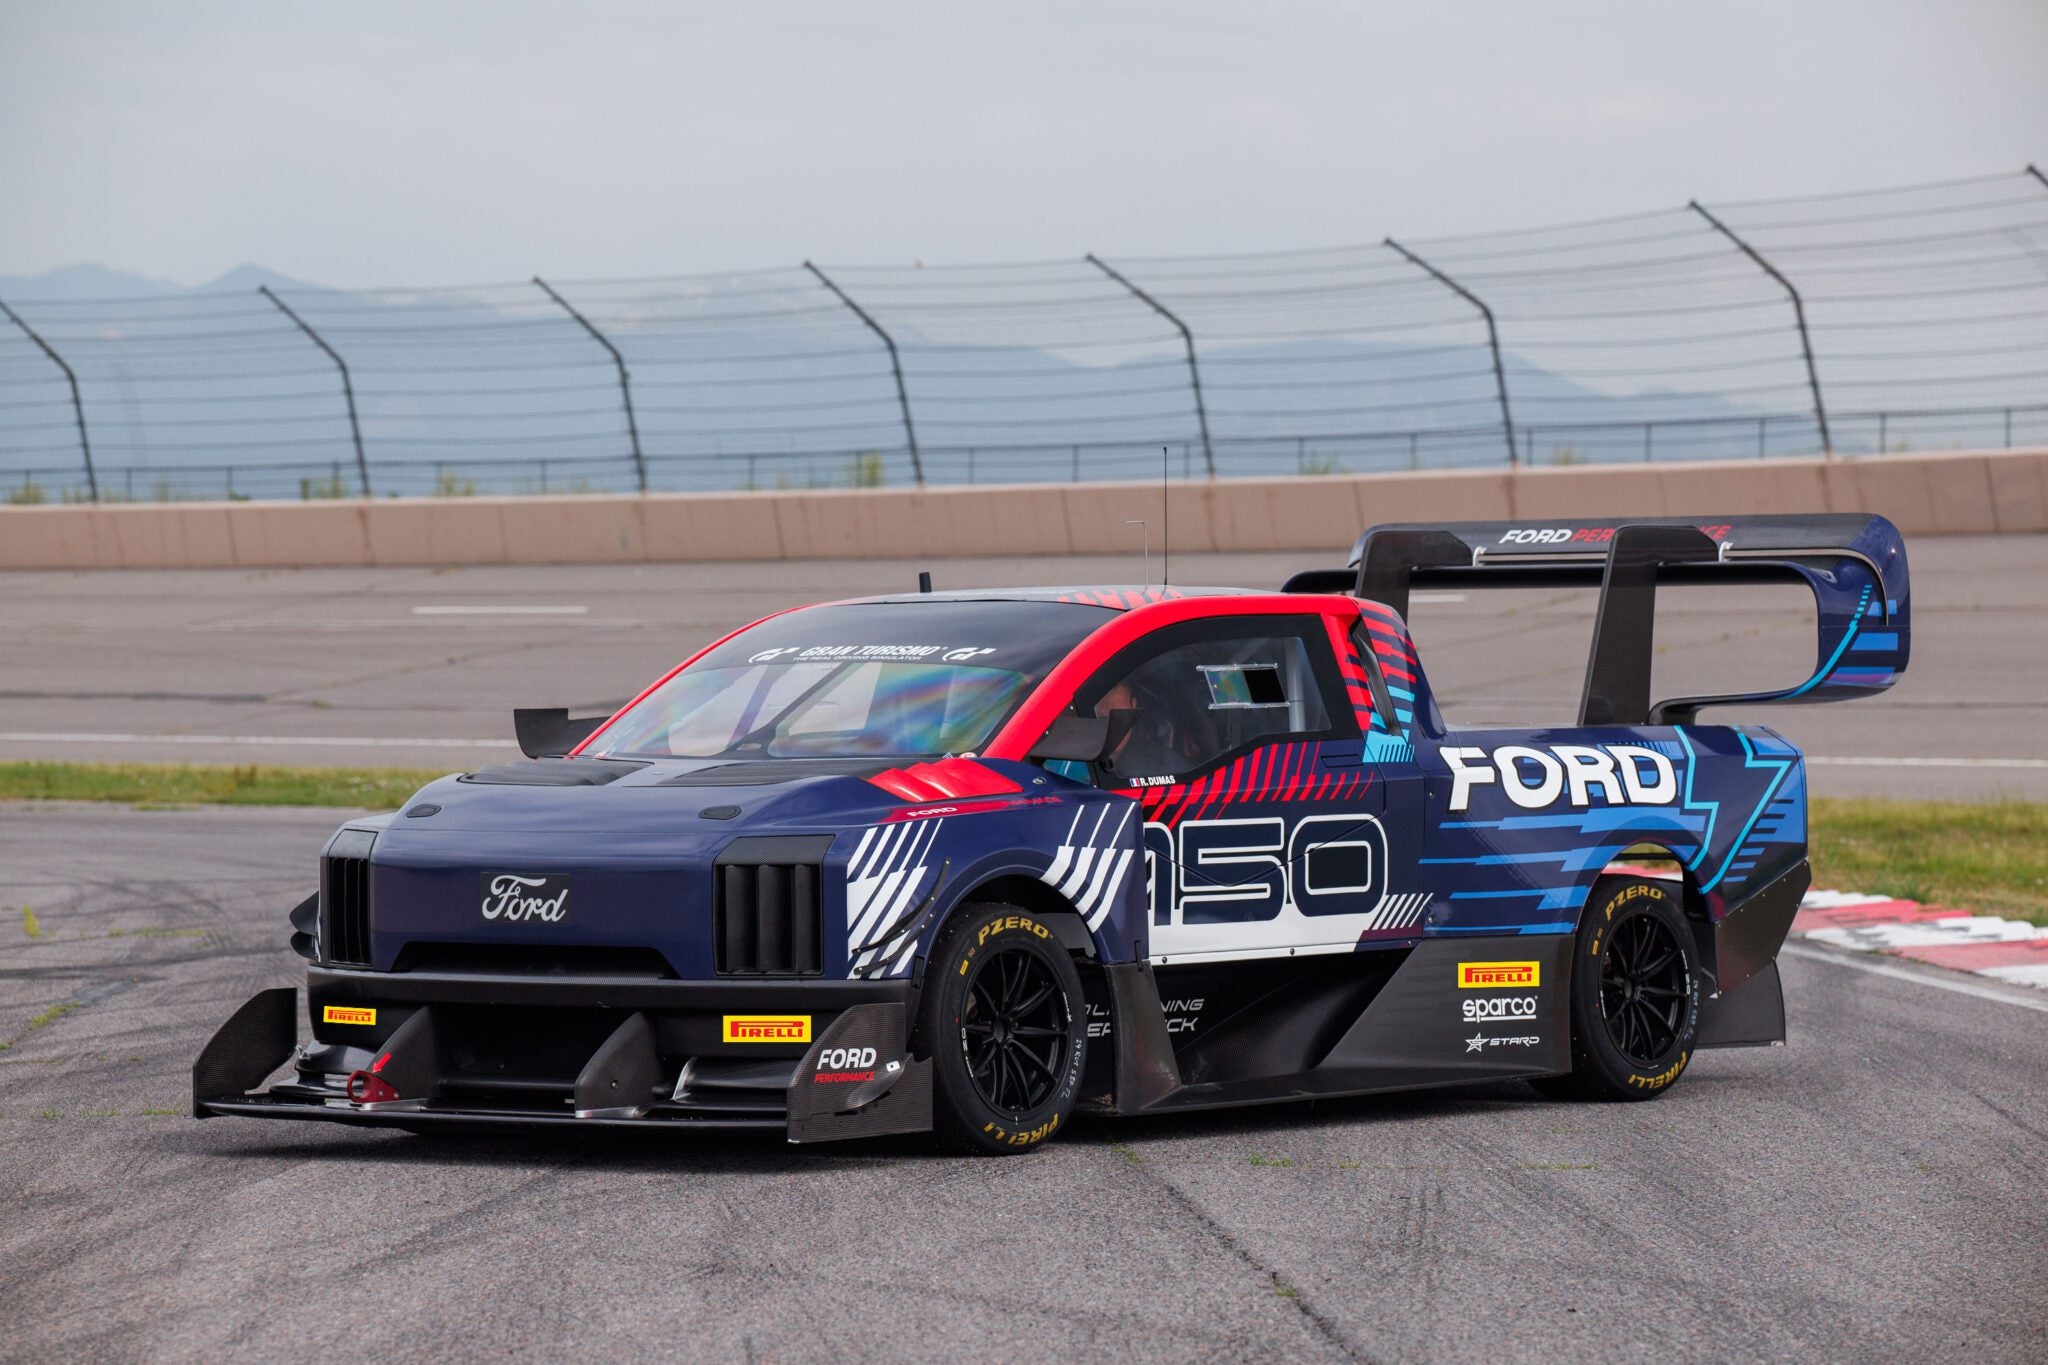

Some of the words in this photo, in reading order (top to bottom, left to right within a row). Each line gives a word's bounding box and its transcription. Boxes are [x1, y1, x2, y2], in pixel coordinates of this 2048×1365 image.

[1498, 529, 1572, 544] FORD
[800, 645, 859, 657] GRAN
[855, 645, 941, 656] TURISMO
[1439, 745, 1677, 811] FORD
[907, 806, 958, 817] FORD
[482, 875, 569, 922] Ford
[1465, 966, 1533, 983] PIRELLI
[328, 1009, 371, 1022] PIRELLI
[1462, 997, 1537, 1023] sparco
[730, 1021, 804, 1038] PIRELLI
[1489, 1036, 1540, 1047] STARD
[817, 1048, 877, 1070] FORD
[814, 1071, 876, 1084] PERFORMANCE
